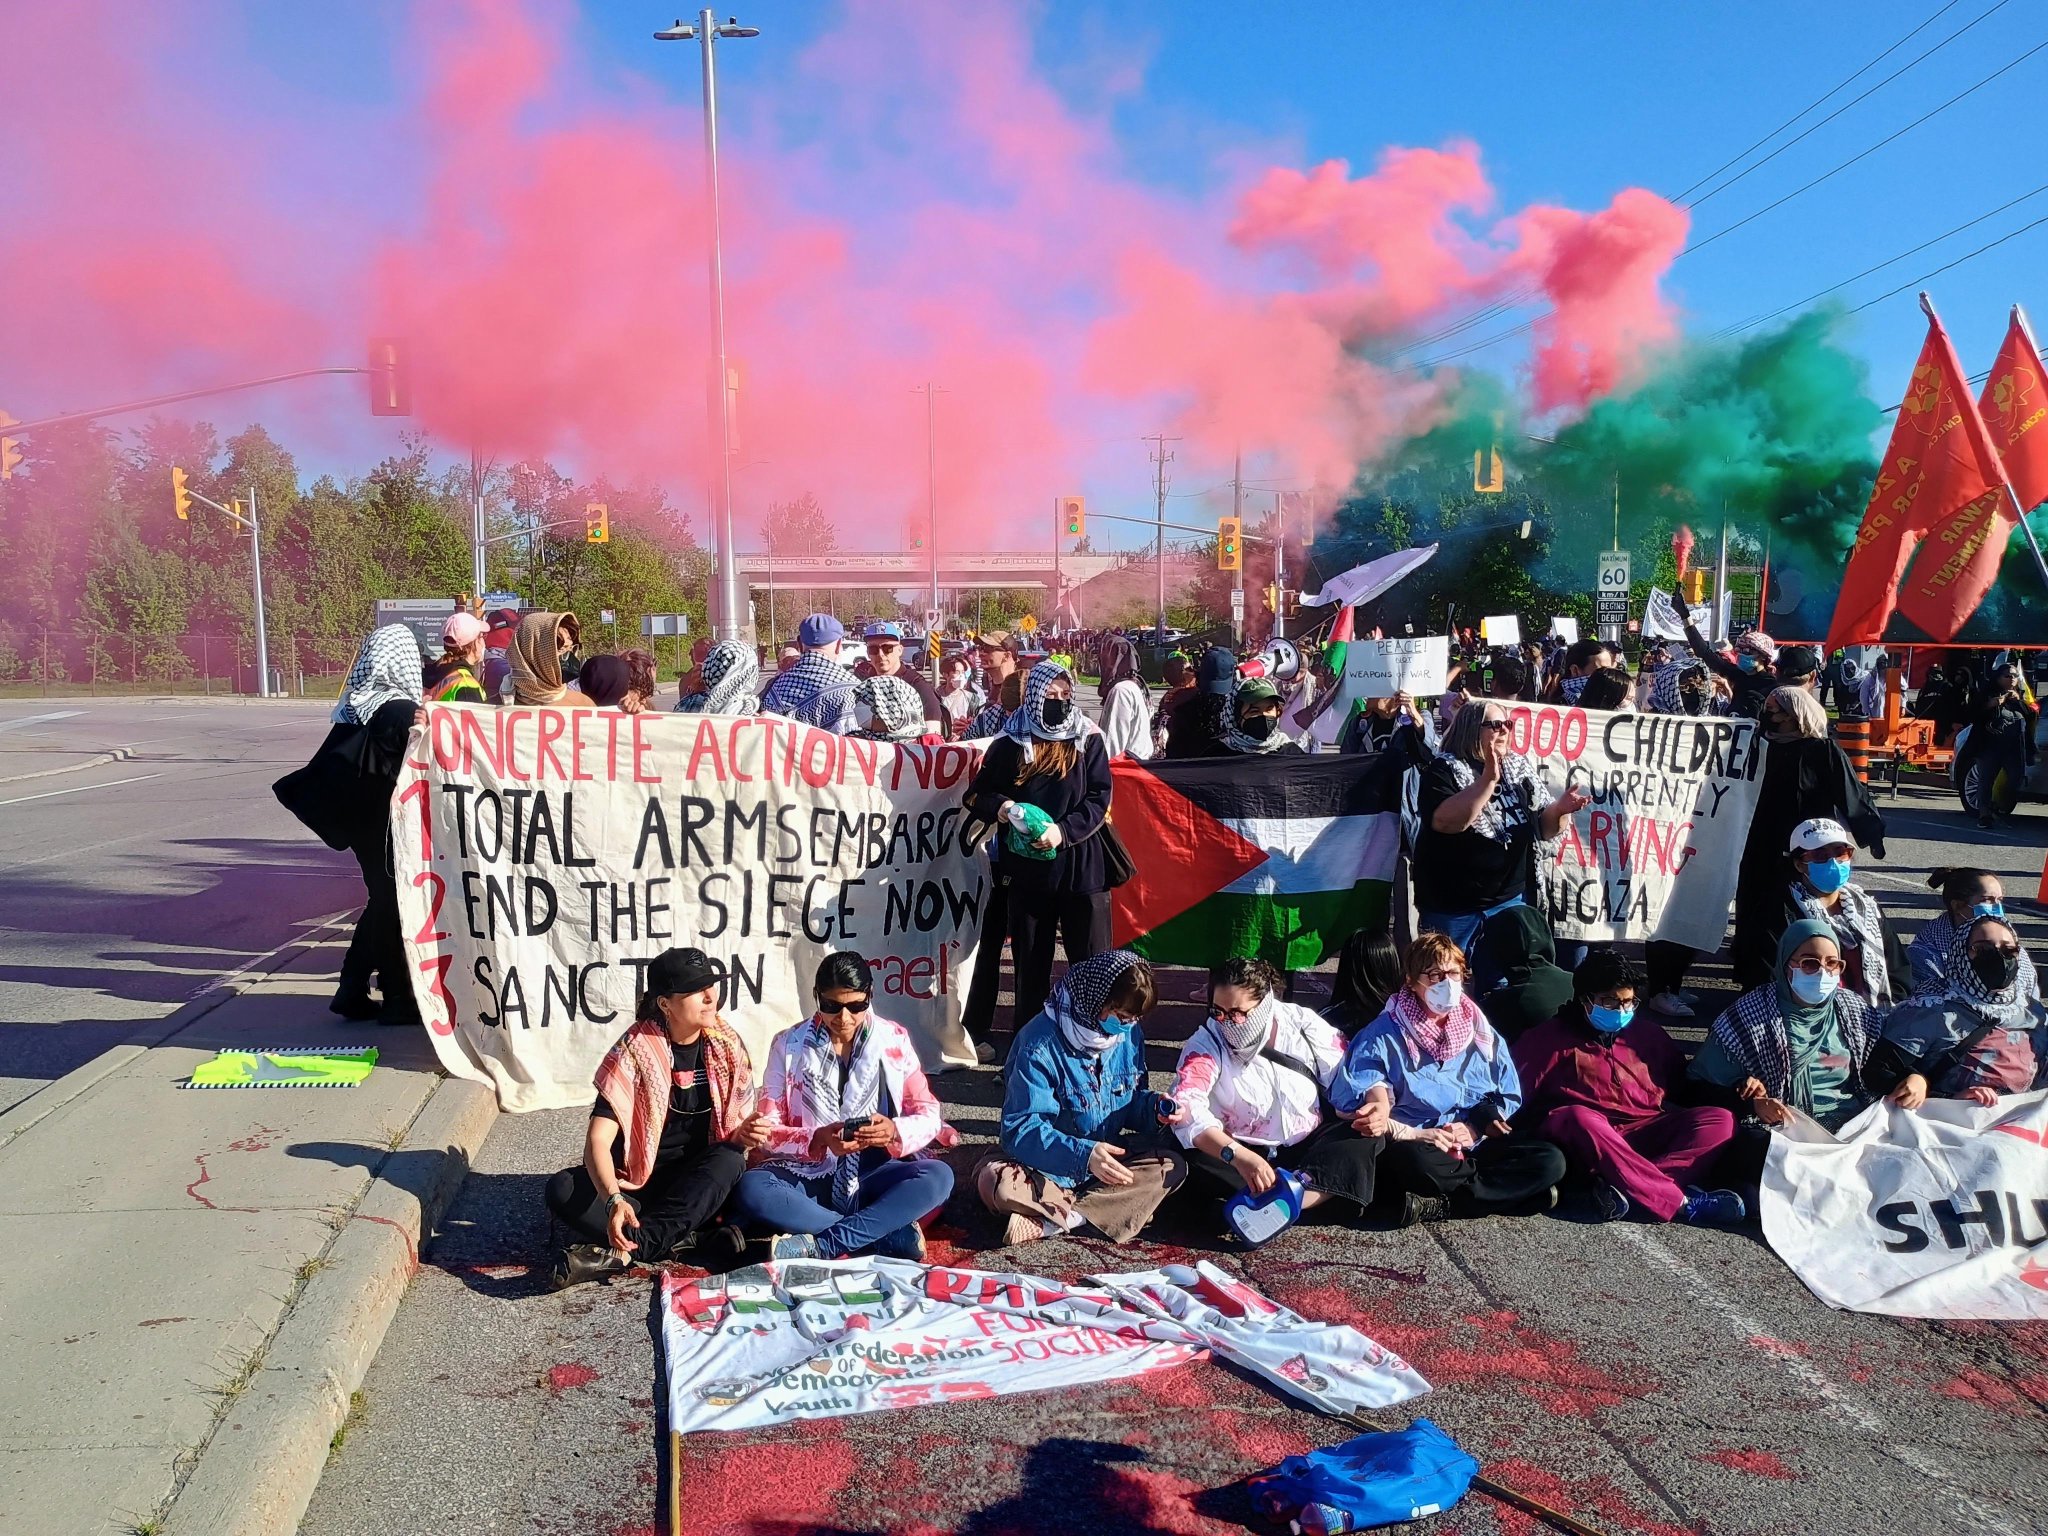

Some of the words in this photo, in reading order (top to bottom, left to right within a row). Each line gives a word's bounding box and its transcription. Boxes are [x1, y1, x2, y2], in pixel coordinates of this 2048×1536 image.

[1602, 568, 1626, 585] 60
[1600, 602, 1626, 610] BEGINS
[1601, 612, 1624, 622] DÉBUT
[1375, 639, 1427, 653] PEACE!
[1395, 656, 1413, 664] NOT
[1349, 670, 1393, 678] WEAPONS
[686, 717, 878, 789] ACTION
[1602, 713, 1760, 782] CHILDREN
[1566, 765, 1730, 818] CURRENTLY
[442, 784, 596, 868] TOTAL
[632, 796, 802, 869] ARMS
[811, 806, 991, 869] EMBARGO
[1556, 811, 1697, 876] ARVING
[462, 871, 558, 941] END
[581, 876, 672, 943] THE
[698, 869, 866, 944] SIEGE
[884, 876, 984, 936] NOW
[1576, 879, 1648, 924] GAZA
[474, 953, 765, 1030] SANCTON
[763, 1397, 853, 1416] Youth
